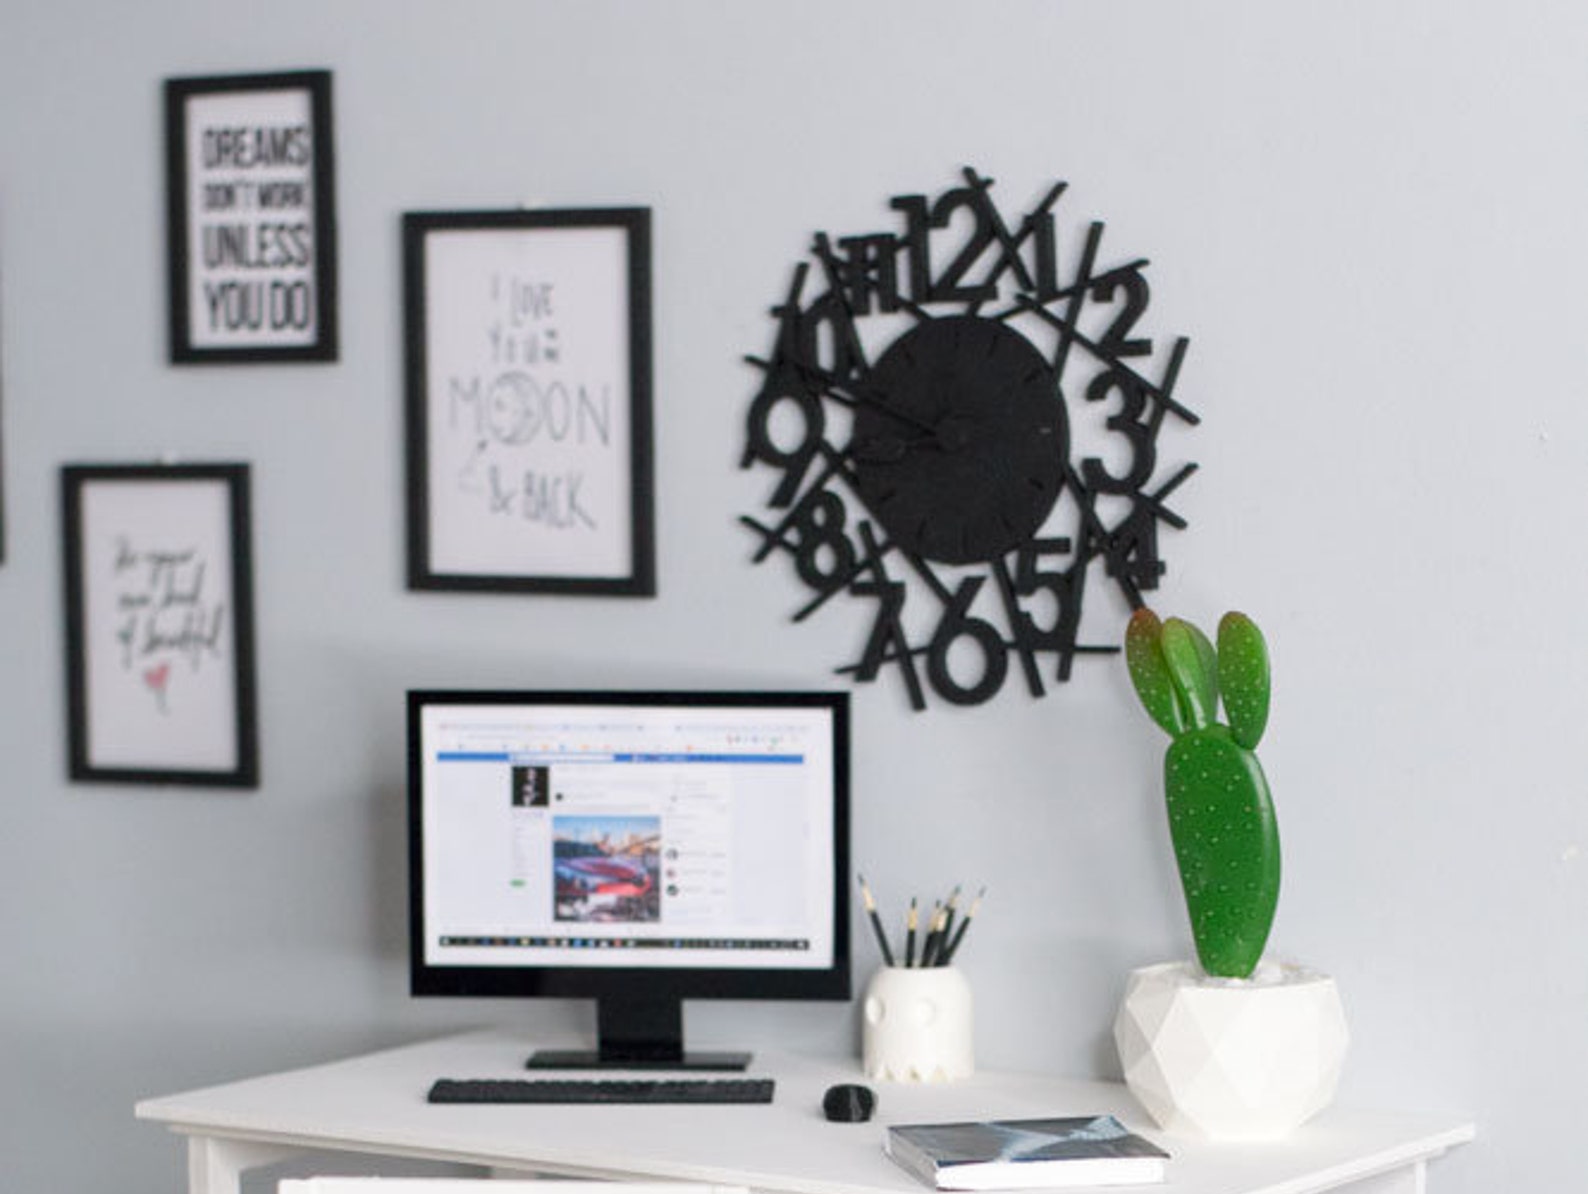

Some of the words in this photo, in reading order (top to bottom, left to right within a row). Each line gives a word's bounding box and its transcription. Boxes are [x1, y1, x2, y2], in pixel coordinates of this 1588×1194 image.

[202, 127, 310, 168] DREAMS
[202, 222, 311, 269] UNLESS
[892, 186, 998, 304] 12
[203, 281, 265, 331] YOU
[269, 280, 311, 330] DO
[1092, 264, 1152, 357] 2
[747, 360, 825, 508] 9
[1082, 370, 1157, 495] 3
[795, 490, 854, 591] 8
[927, 576, 1007, 706] 6
